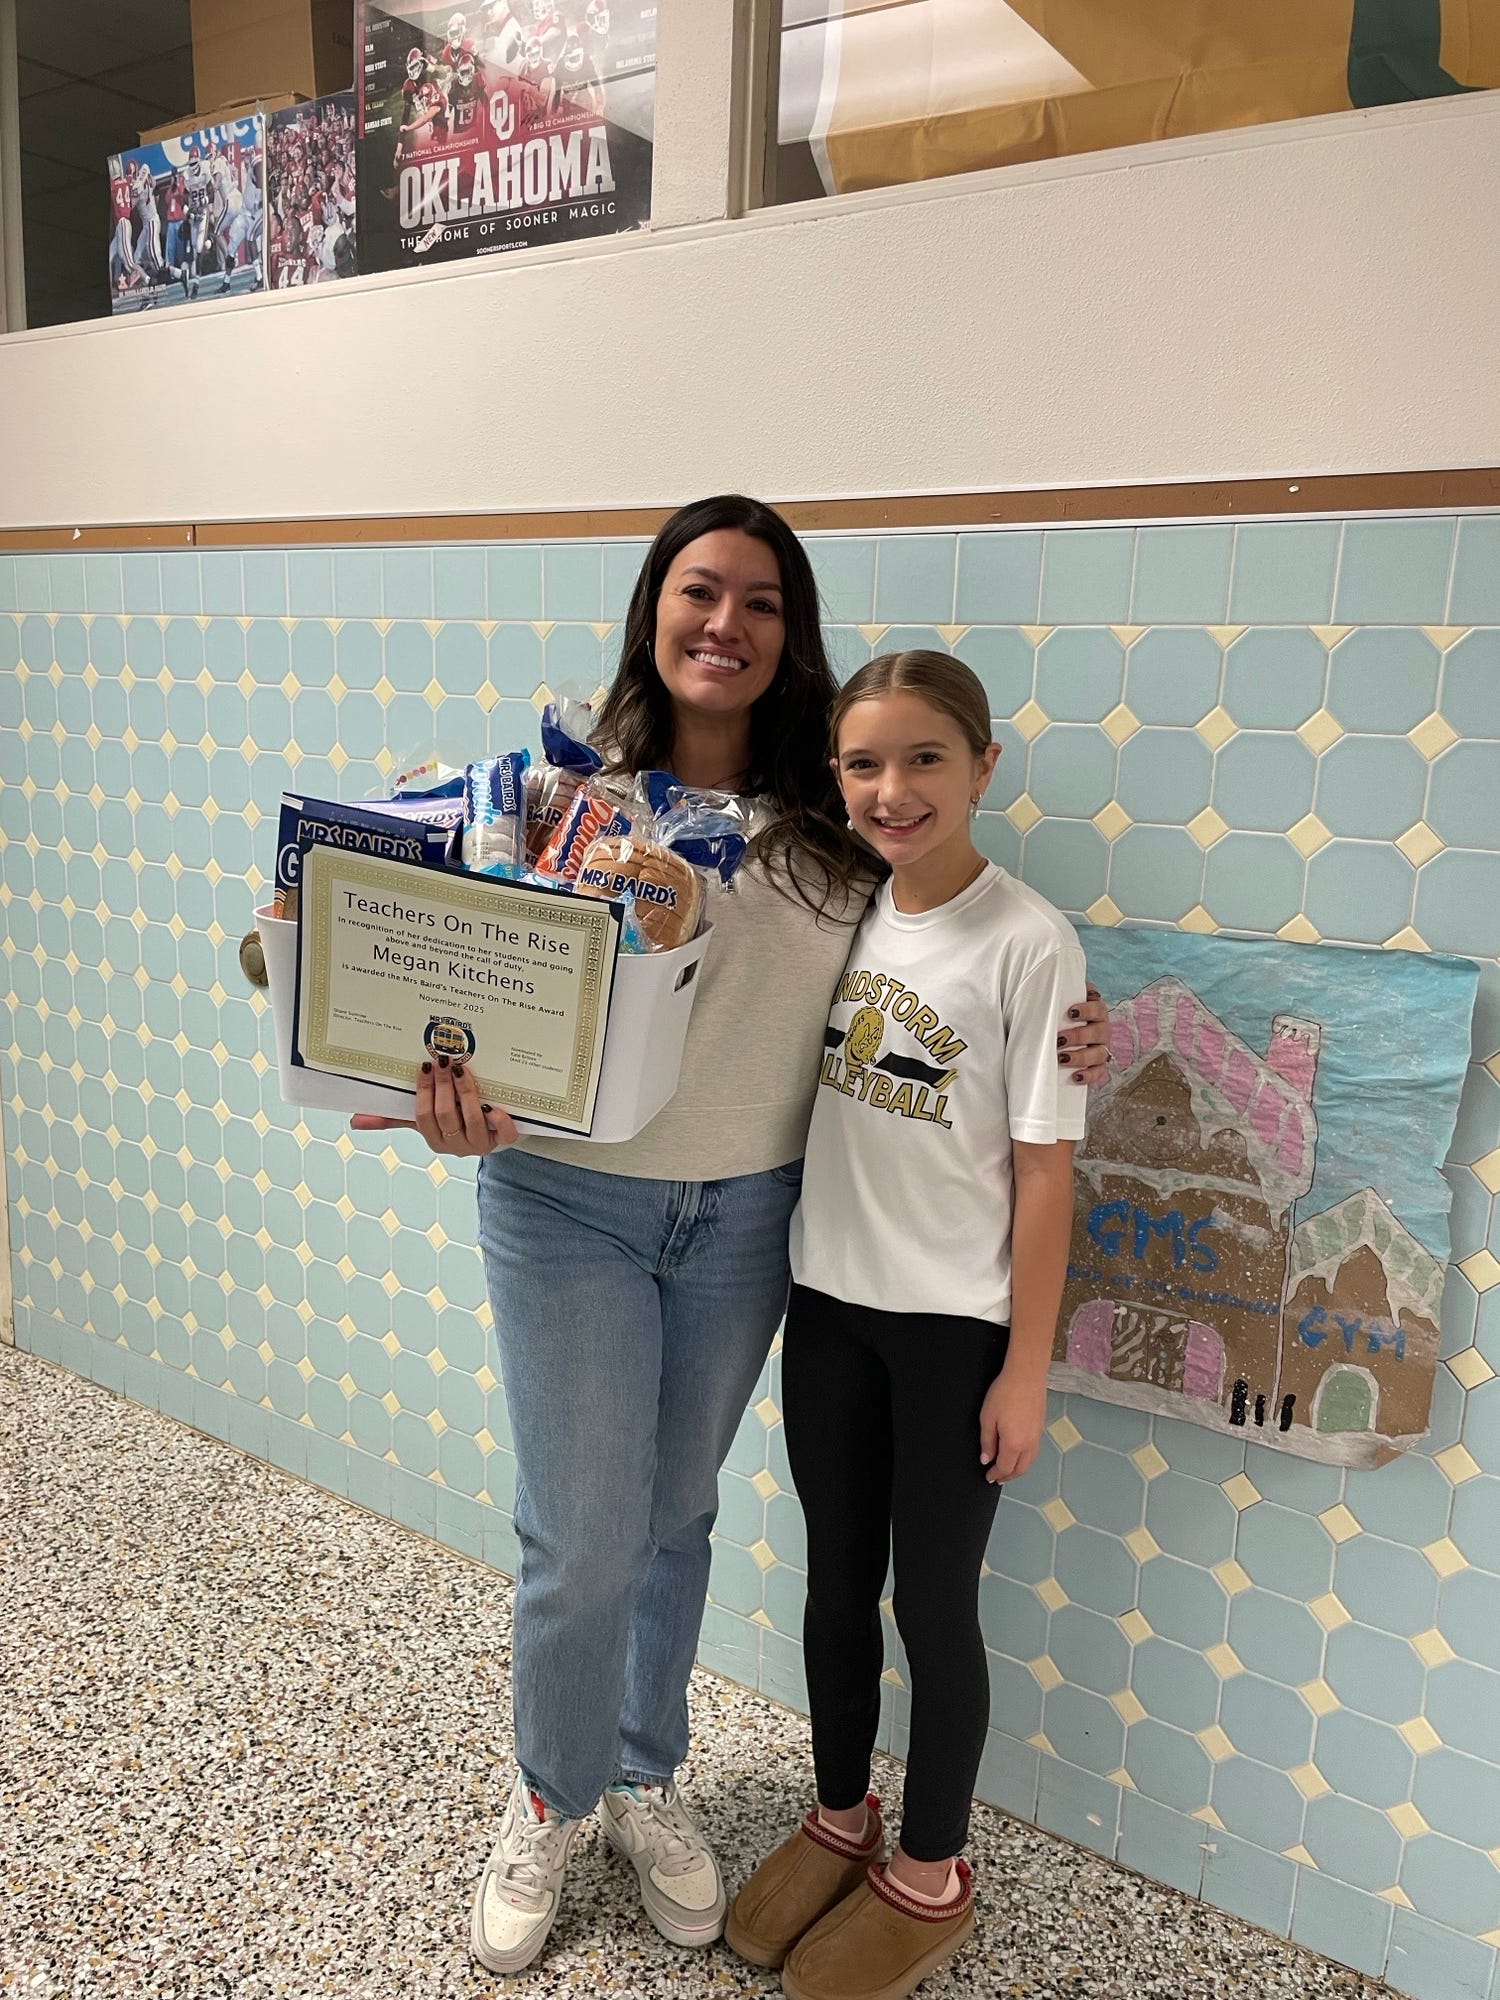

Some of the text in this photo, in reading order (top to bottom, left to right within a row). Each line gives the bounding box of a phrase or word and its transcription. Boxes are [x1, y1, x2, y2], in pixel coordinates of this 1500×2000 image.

[644, 53, 656, 64] STAT
[490, 90, 514, 140] OU
[552, 110, 603, 126] CHAMPIONSHIPS
[406, 148, 432, 159] NATIONAL
[434, 138, 479, 152] CHAMPIONSHIPS
[400, 125, 616, 230] OKLAHOMA
[400, 236, 421, 249] THE
[480, 224, 496, 236] OF
[506, 212, 558, 231] SOONER
[570, 202, 616, 220] MAGIC
[476, 240, 528, 254] SOONERSPORTS.COM
[279, 266, 304, 288] 44
[500, 757, 517, 812] MRS BAIRD'S
[526, 804, 563, 826] BAIR
[562, 797, 614, 880] Donuts
[298, 819, 341, 844] MRS
[342, 829, 422, 861] BAIRD'S
[278, 843, 300, 887] G
[580, 868, 610, 888] MRS
[611, 874, 678, 910] BAIRD'S
[338, 916, 345, 924] In
[348, 920, 394, 934] recognition
[407, 931, 420, 940] her
[422, 936, 465, 950] dedication
[467, 945, 476, 953] to
[478, 947, 492, 955] her
[494, 952, 530, 964] students
[532, 959, 547, 968] and
[550, 963, 574, 974] going
[344, 891, 570, 956] Teachers On The Rise
[373, 944, 534, 994] Megan Kitchens
[385, 936, 409, 946] above
[411, 942, 426, 950] and
[429, 945, 459, 958] beyond
[461, 952, 474, 960] the
[476, 956, 491, 964] call
[351, 965, 385, 978] awarded
[387, 973, 400, 981] the
[402, 976, 418, 985] Mrs
[420, 980, 447, 991] Baird's
[449, 986, 485, 1000] Teachers
[487, 994, 499, 1002] On
[502, 998, 517, 1006] The
[519, 1002, 536, 1011] Rise
[538, 1006, 564, 1016] Award
[419, 993, 484, 1014] November 2025
[832, 971, 968, 1064] NDSTORM
[821, 1053, 953, 1130] LLEYBALL
[1088, 1198, 1220, 1272] GMS
[1299, 1306, 1406, 1360] GYM
